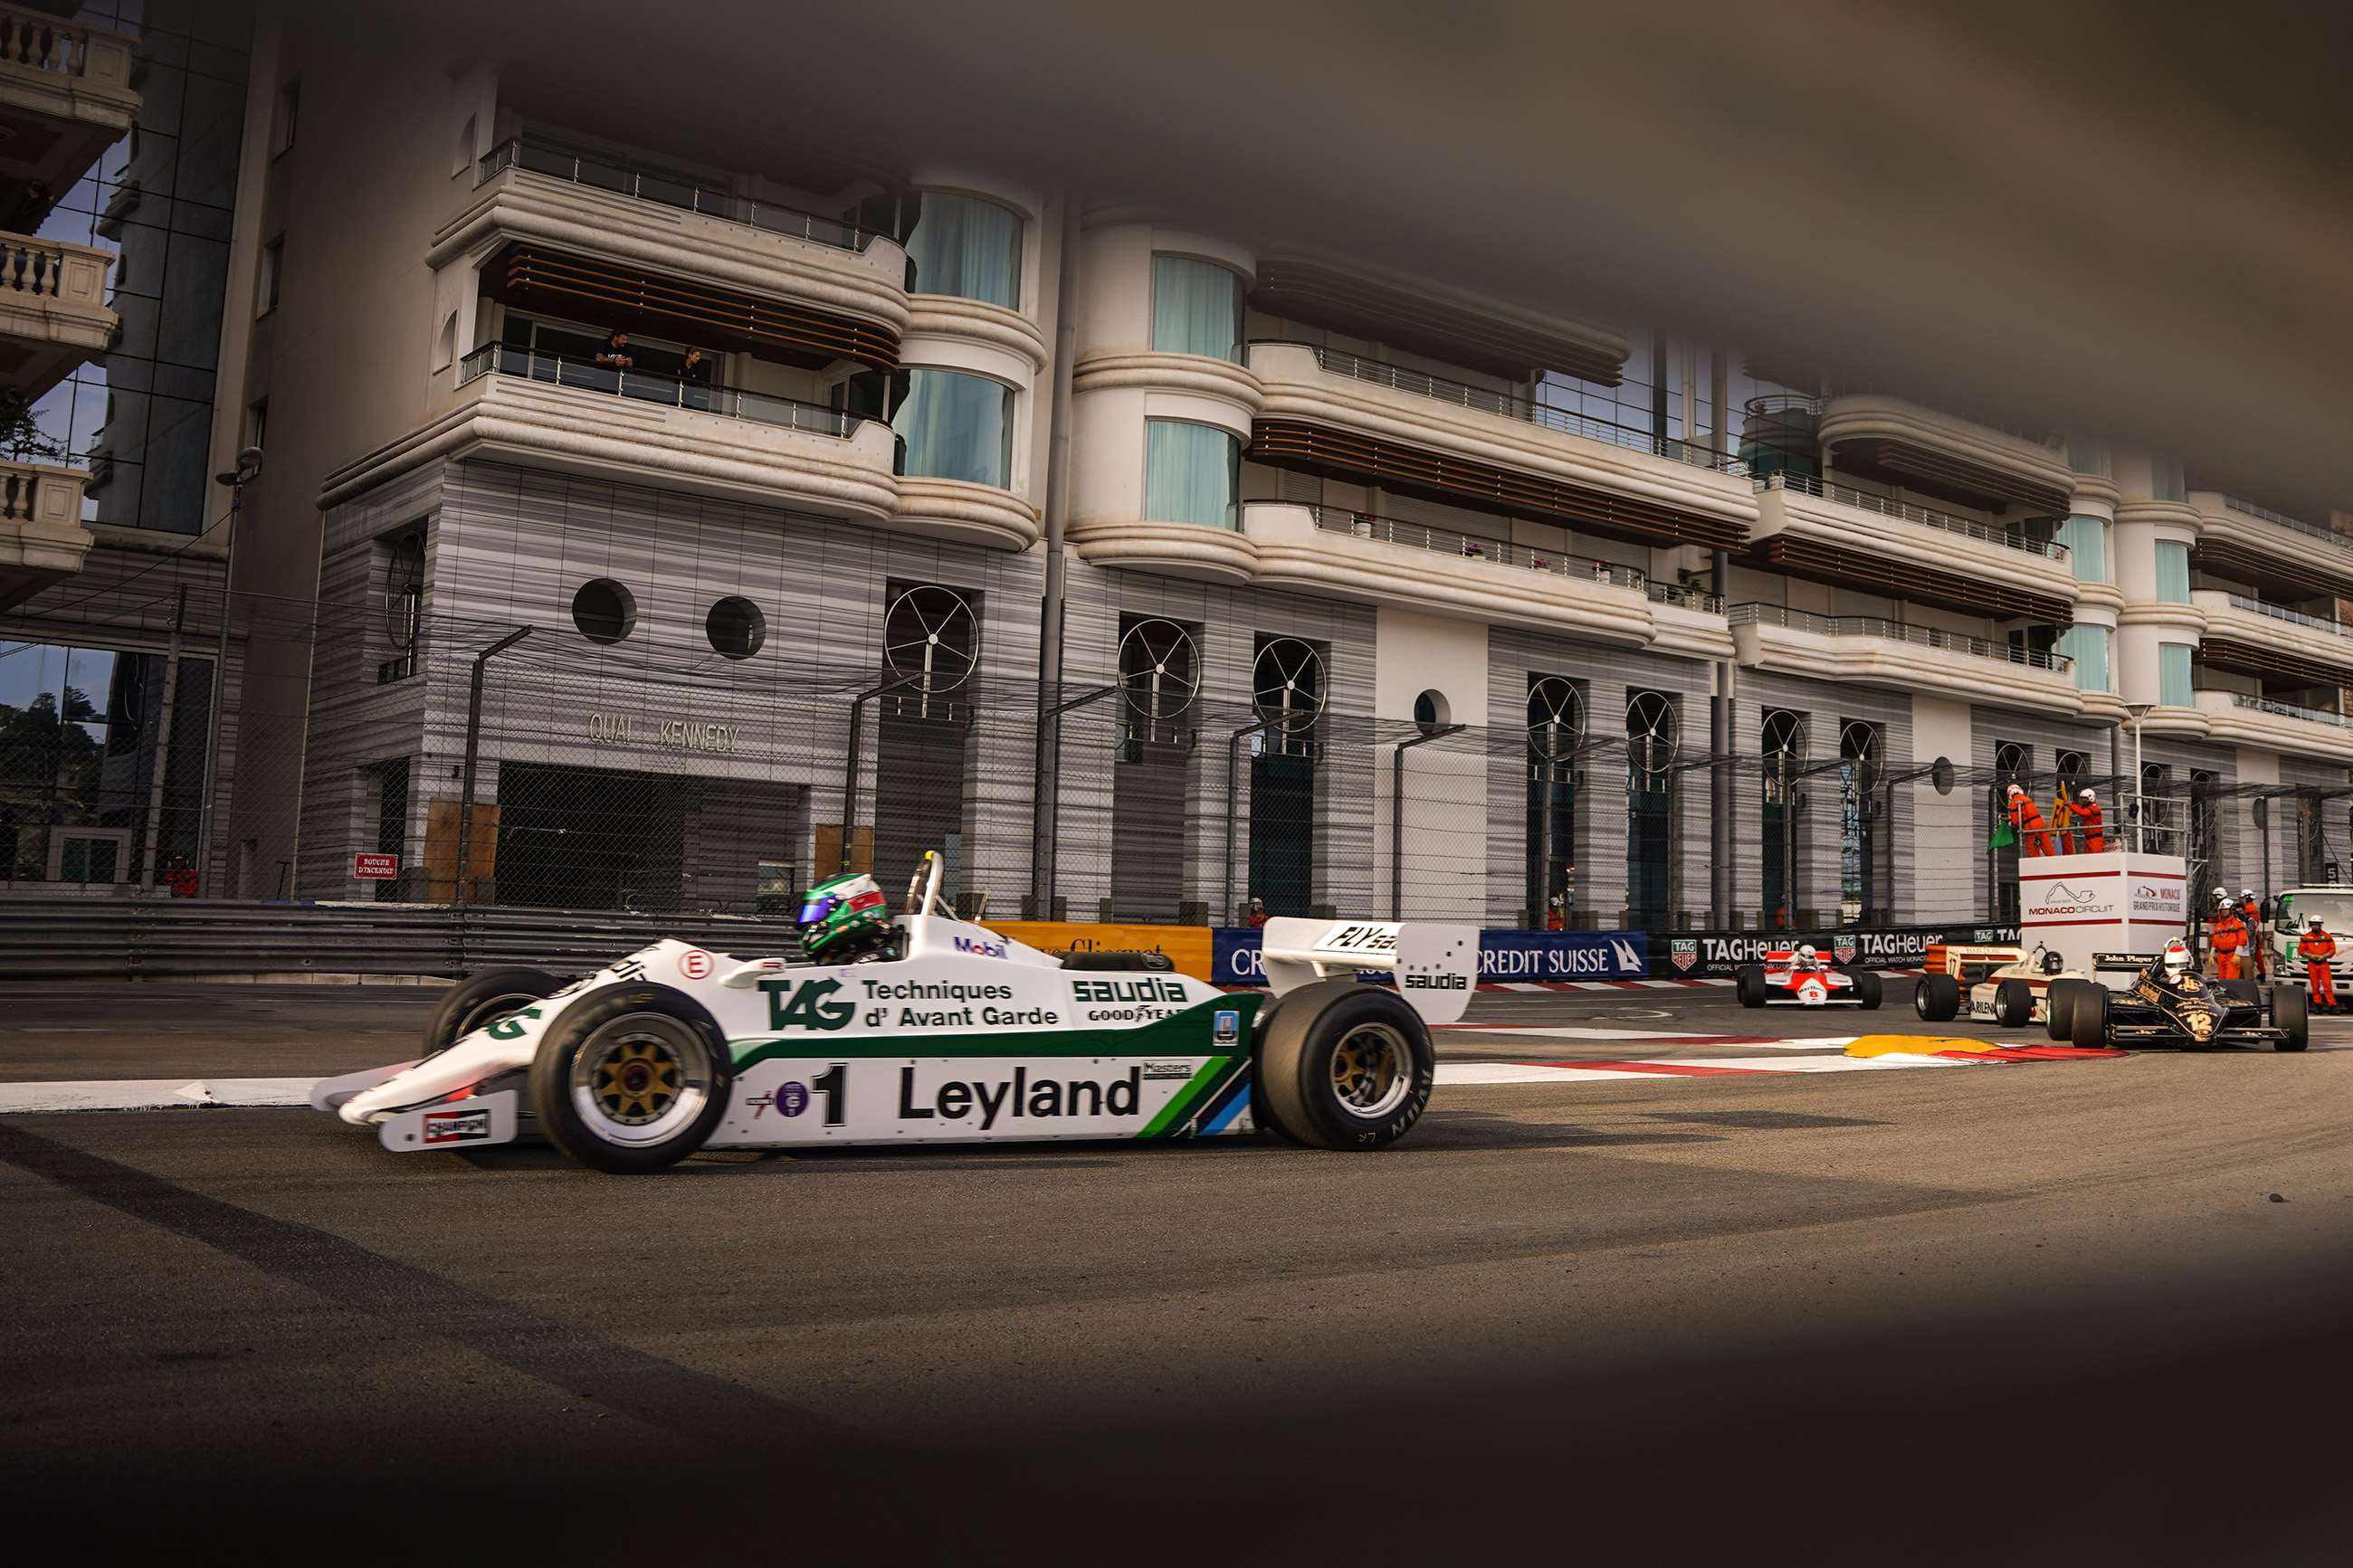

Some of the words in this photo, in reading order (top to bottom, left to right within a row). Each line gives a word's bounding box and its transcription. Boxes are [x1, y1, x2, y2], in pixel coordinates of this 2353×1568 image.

[589, 713, 632, 744] QUAI
[660, 720, 739, 752] KENNEDY
[1836, 937, 1854, 947] TAG
[1977, 932, 1992, 940] TAG
[1674, 942, 1694, 952] TAG
[688, 955, 705, 974] E
[1548, 948, 1609, 974] SUISSE
[1673, 953, 1695, 965] HEUER
[2126, 955, 2153, 963] Player
[862, 980, 1013, 1003] Techniques
[1072, 977, 1188, 1003] saudia
[1405, 973, 1467, 990] saudia
[757, 977, 857, 1031] TAG
[899, 1007, 974, 1027] Avant
[982, 1006, 1059, 1026] Garde
[2186, 1014, 2212, 1032] 12
[812, 1062, 849, 1127] 1
[900, 1067, 1141, 1130] Leyland
